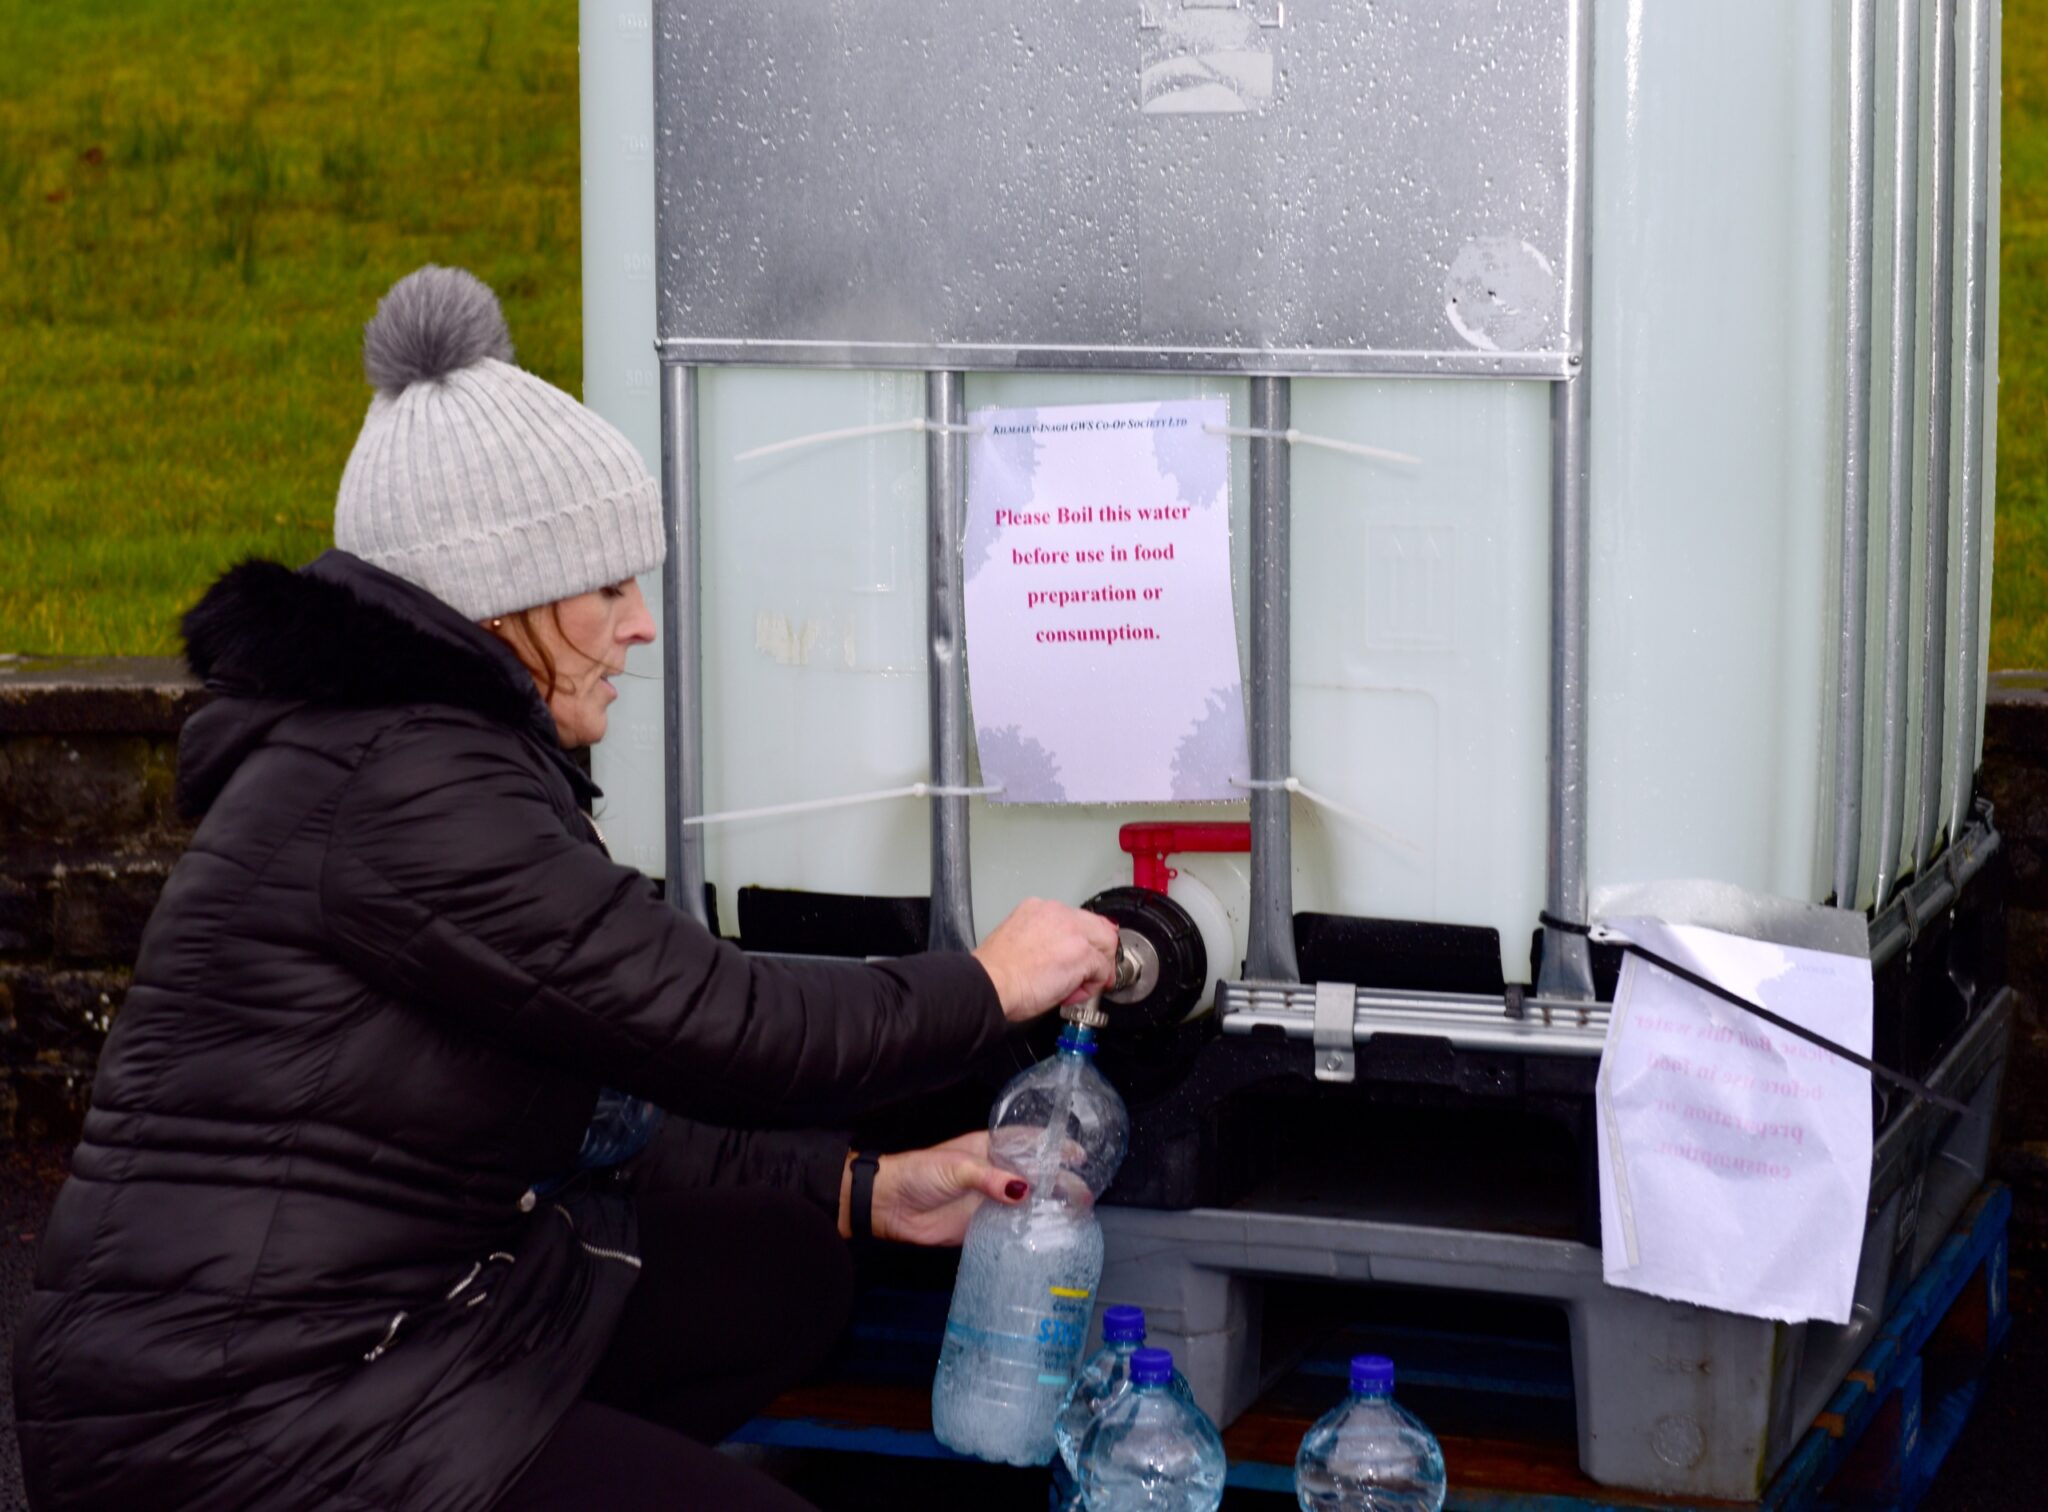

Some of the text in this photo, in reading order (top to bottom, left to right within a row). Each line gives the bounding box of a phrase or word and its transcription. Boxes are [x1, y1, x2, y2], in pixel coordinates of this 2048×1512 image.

[1071, 422, 1094, 431] GWS
[1127, 418, 1168, 429] SOCIETY
[1168, 417, 1188, 427] LTD
[995, 505, 1191, 527] Please Boil this water
[1012, 543, 1175, 565] before use in food
[1028, 585, 1163, 609] preparation or
[1035, 624, 1161, 645] consumption.
